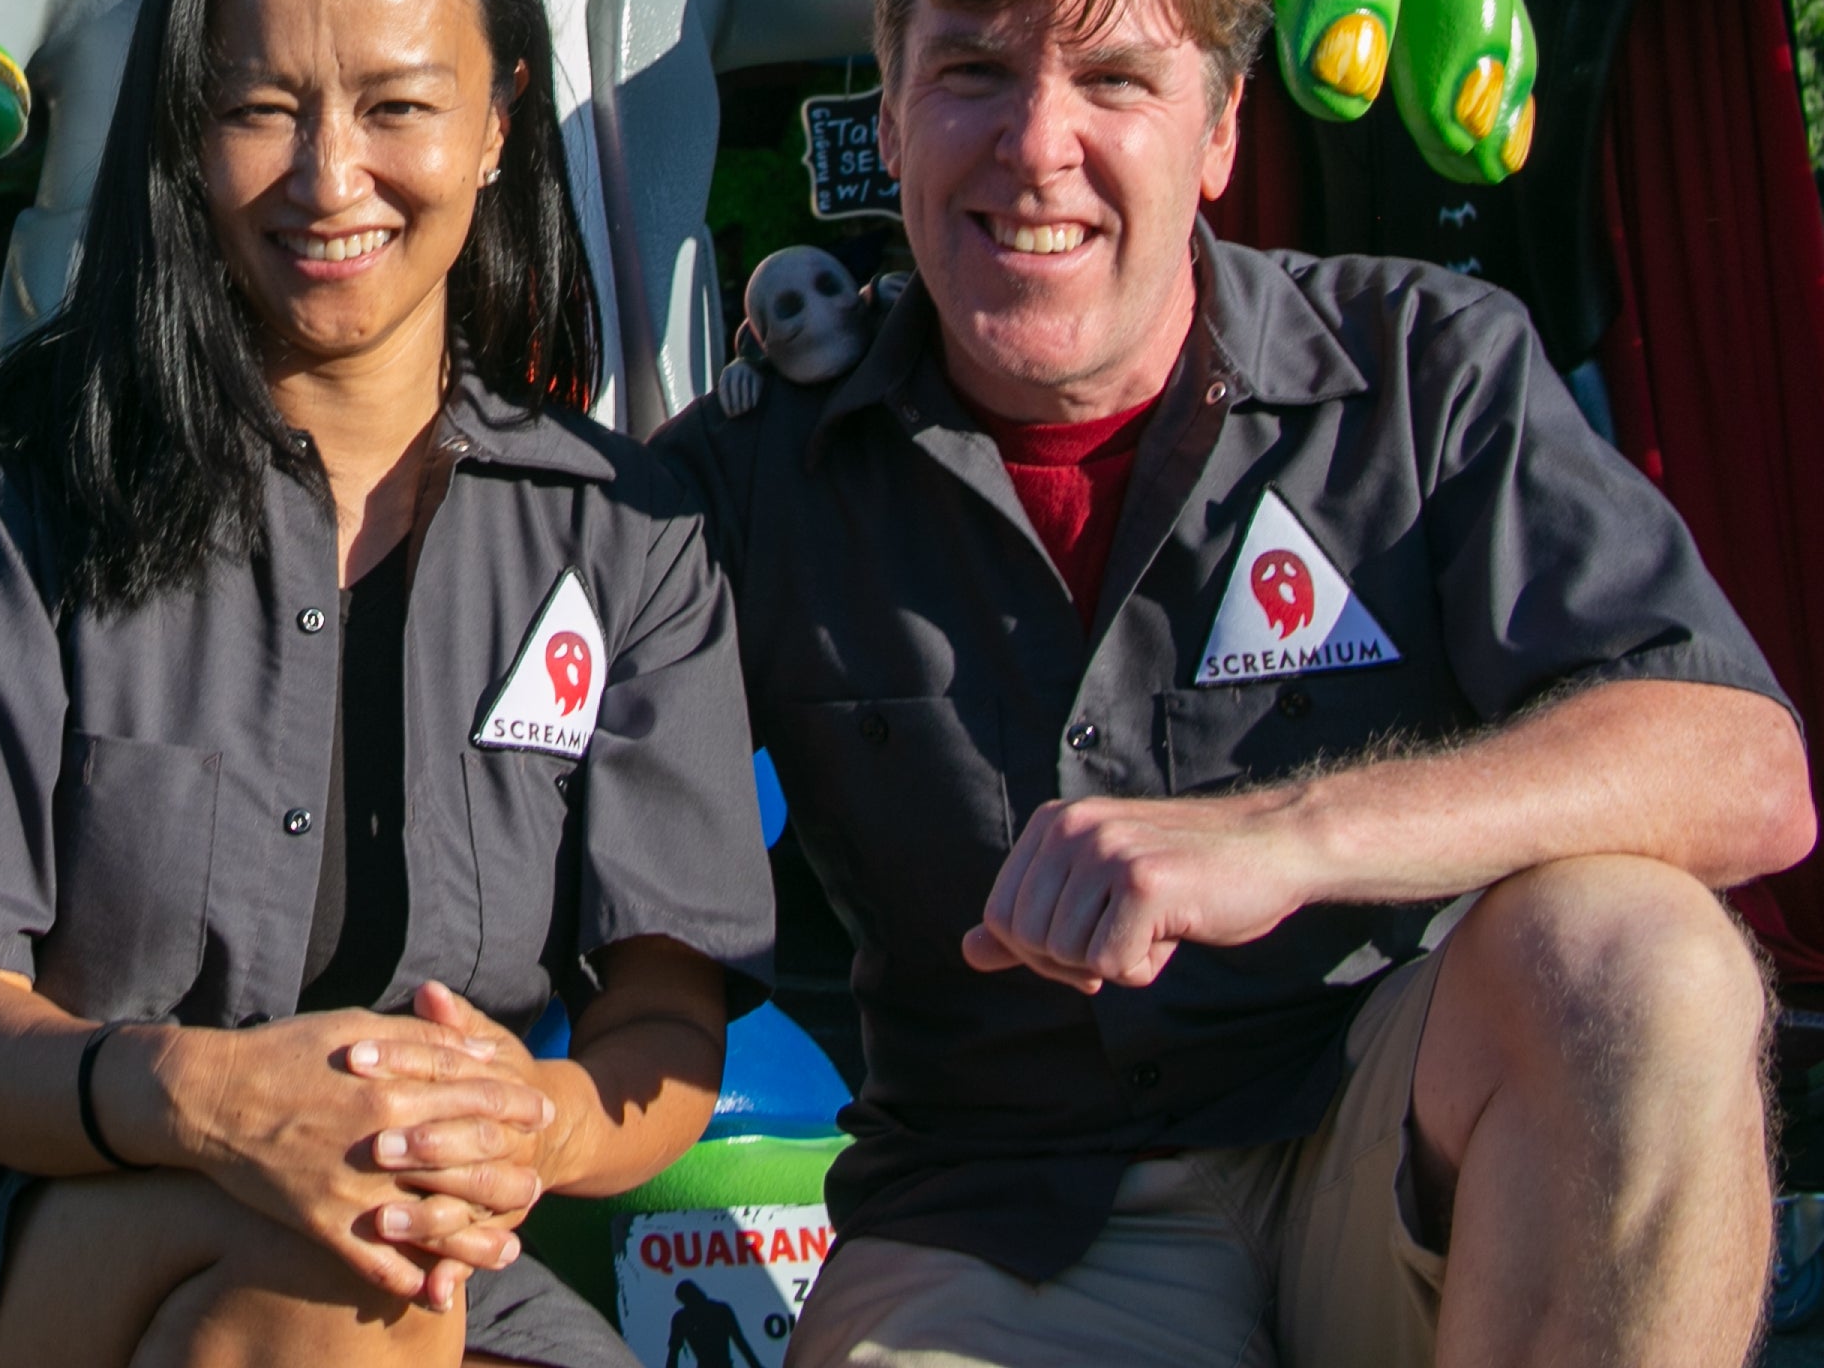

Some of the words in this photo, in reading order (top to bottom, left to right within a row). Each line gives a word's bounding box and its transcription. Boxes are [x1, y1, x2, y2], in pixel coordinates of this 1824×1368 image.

[1207, 640, 1383, 678] SCREAMIUM
[494, 718, 587, 750] SCREAMI
[640, 1226, 837, 1274] QUARAN
[792, 1278, 809, 1302] Z
